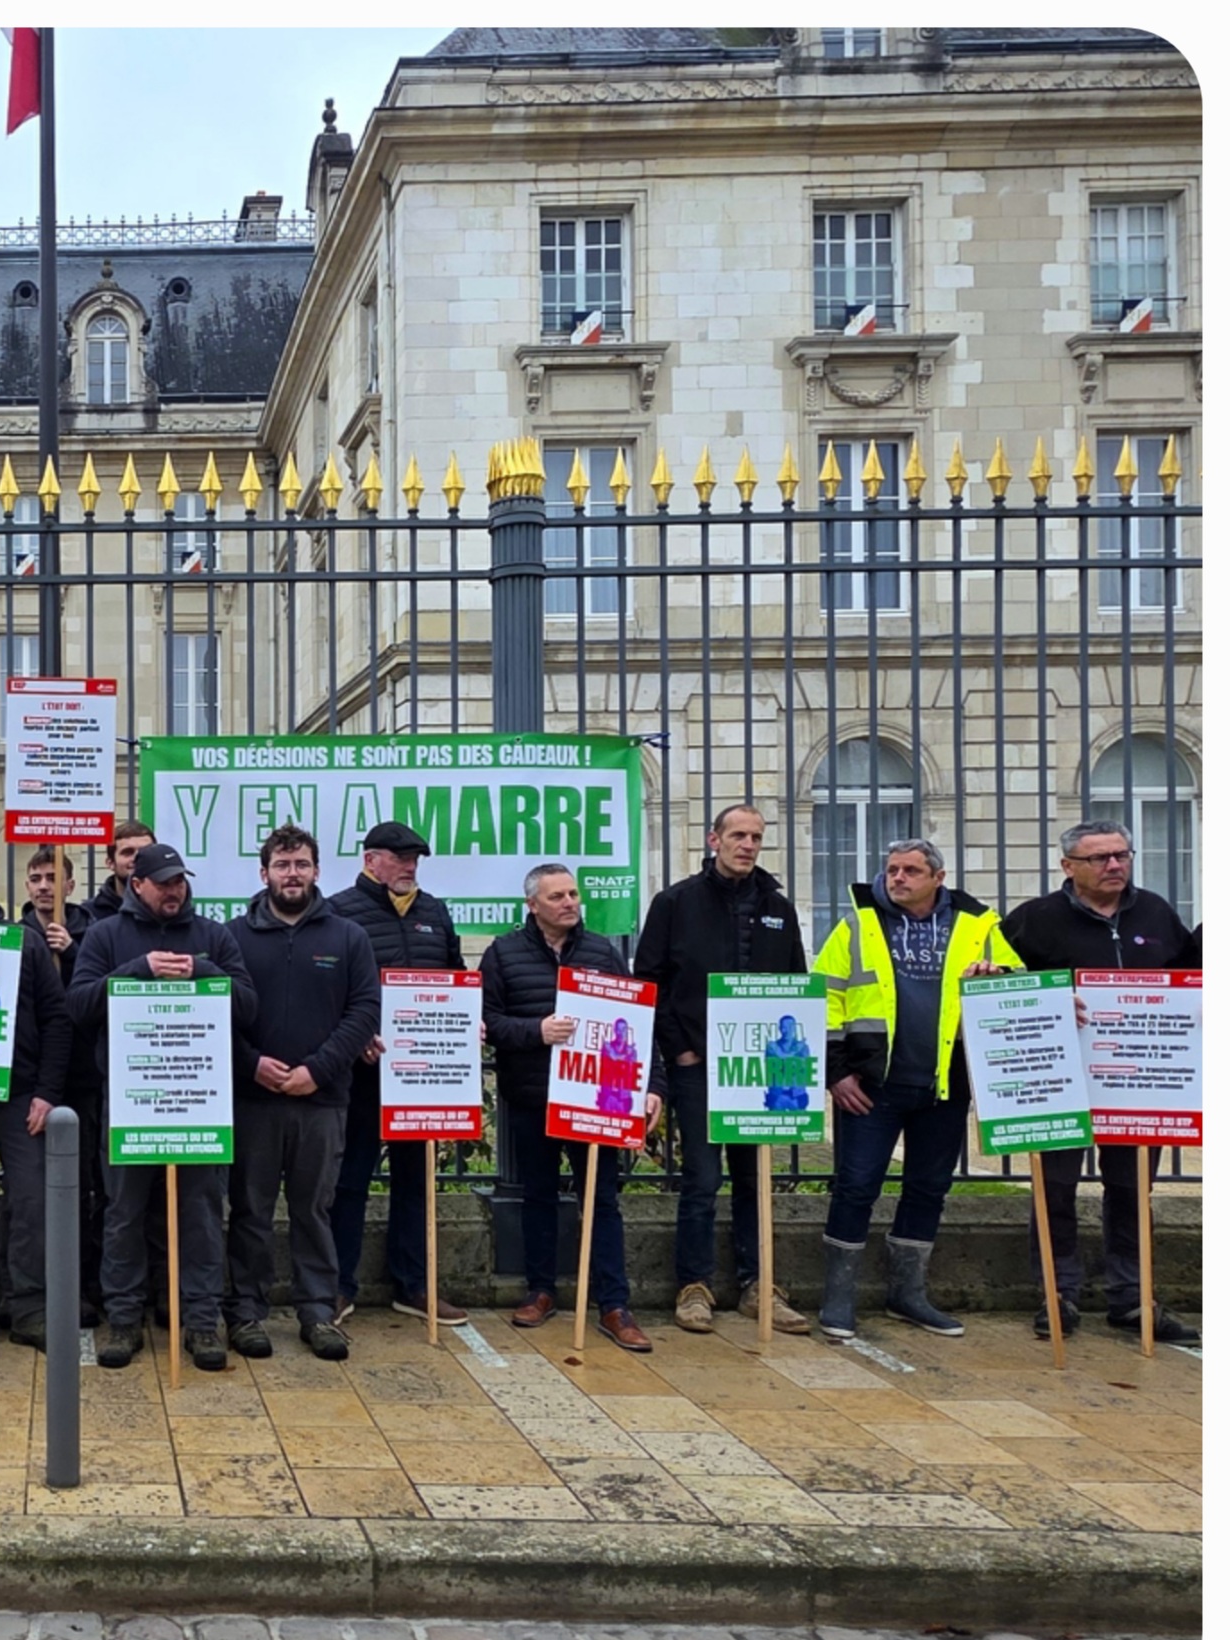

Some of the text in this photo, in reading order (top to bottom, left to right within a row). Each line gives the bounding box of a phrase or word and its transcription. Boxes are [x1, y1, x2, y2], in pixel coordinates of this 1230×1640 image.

[192, 742, 592, 769] VOS DÉCISIONS NE SONT PAS DES CADEAUX !
[172, 782, 613, 858] Y EN A MARRE
[584, 876, 637, 889] CNATP
[194, 903, 226, 926] LES
[444, 899, 519, 925] ÉRITENT
[717, 1022, 738, 1054] Y
[557, 1048, 644, 1093] MARRE
[717, 1056, 819, 1088] MARRE
